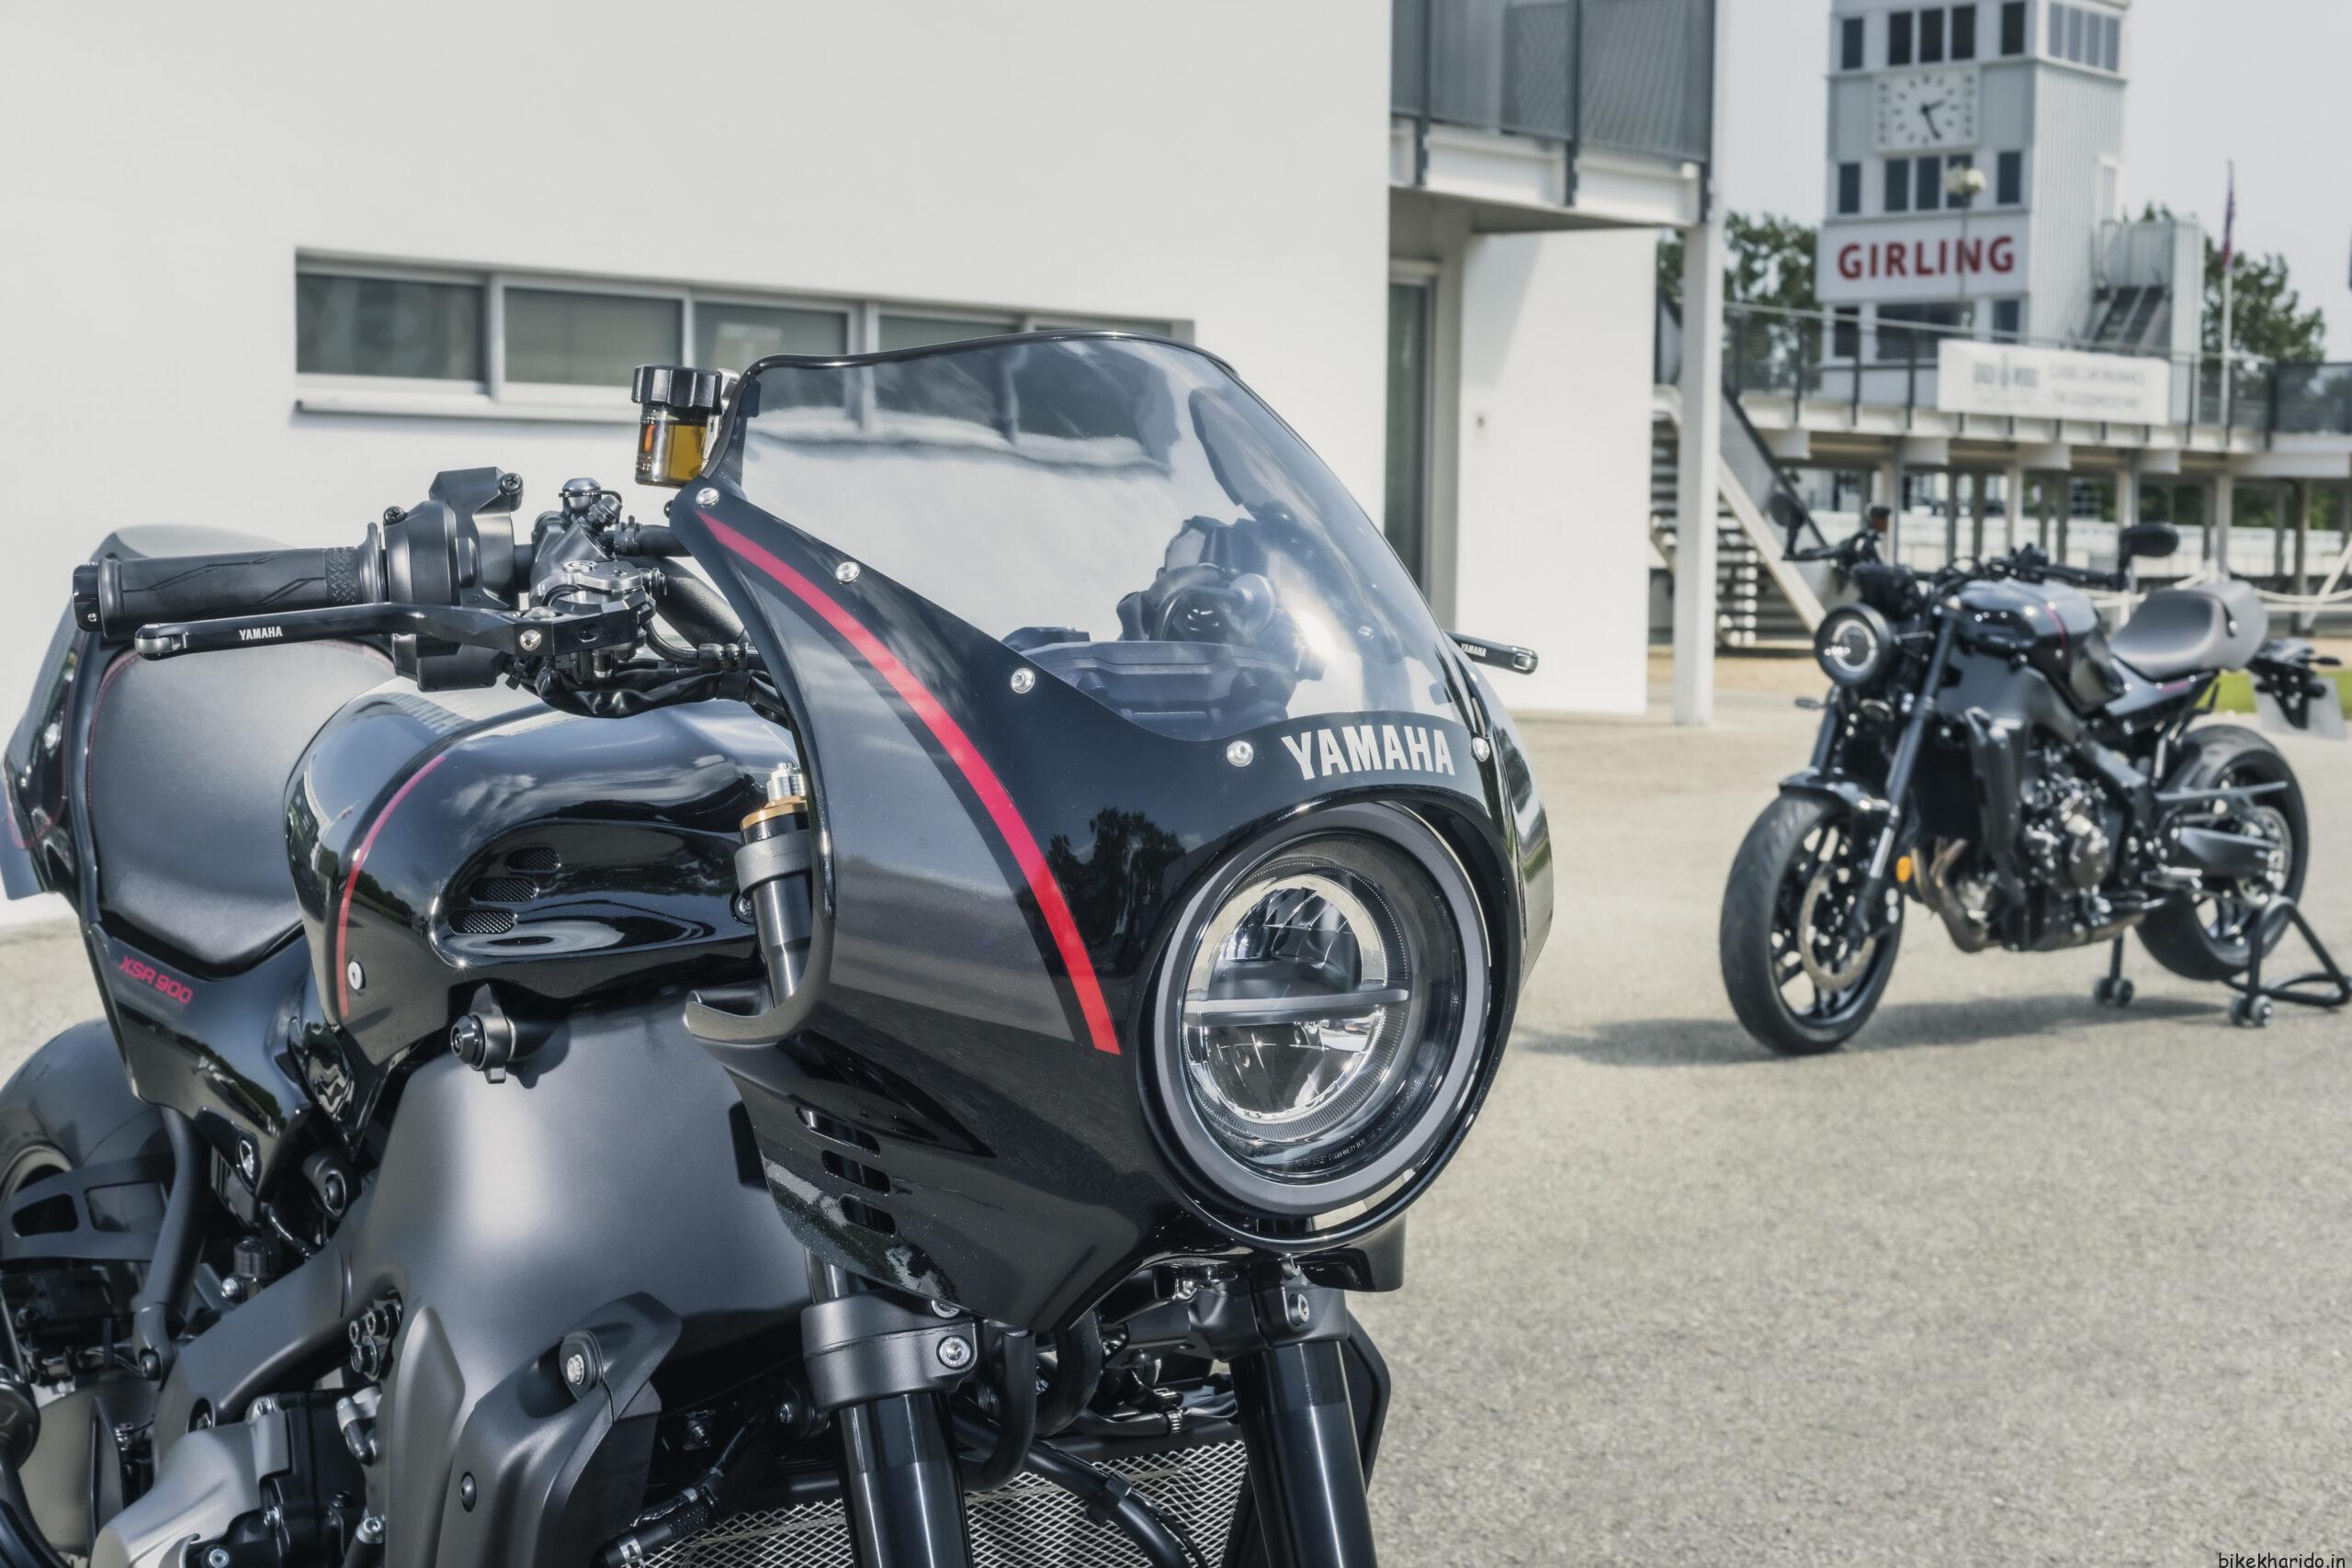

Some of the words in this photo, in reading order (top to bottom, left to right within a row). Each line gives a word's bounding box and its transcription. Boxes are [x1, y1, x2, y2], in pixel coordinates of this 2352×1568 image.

[1838, 235, 2014, 280] GIRLING
[239, 626, 283, 640] YAMAHA
[1281, 725, 1455, 781] YAMAHA
[119, 956, 156, 984] XSR
[155, 974, 193, 1004] 900
